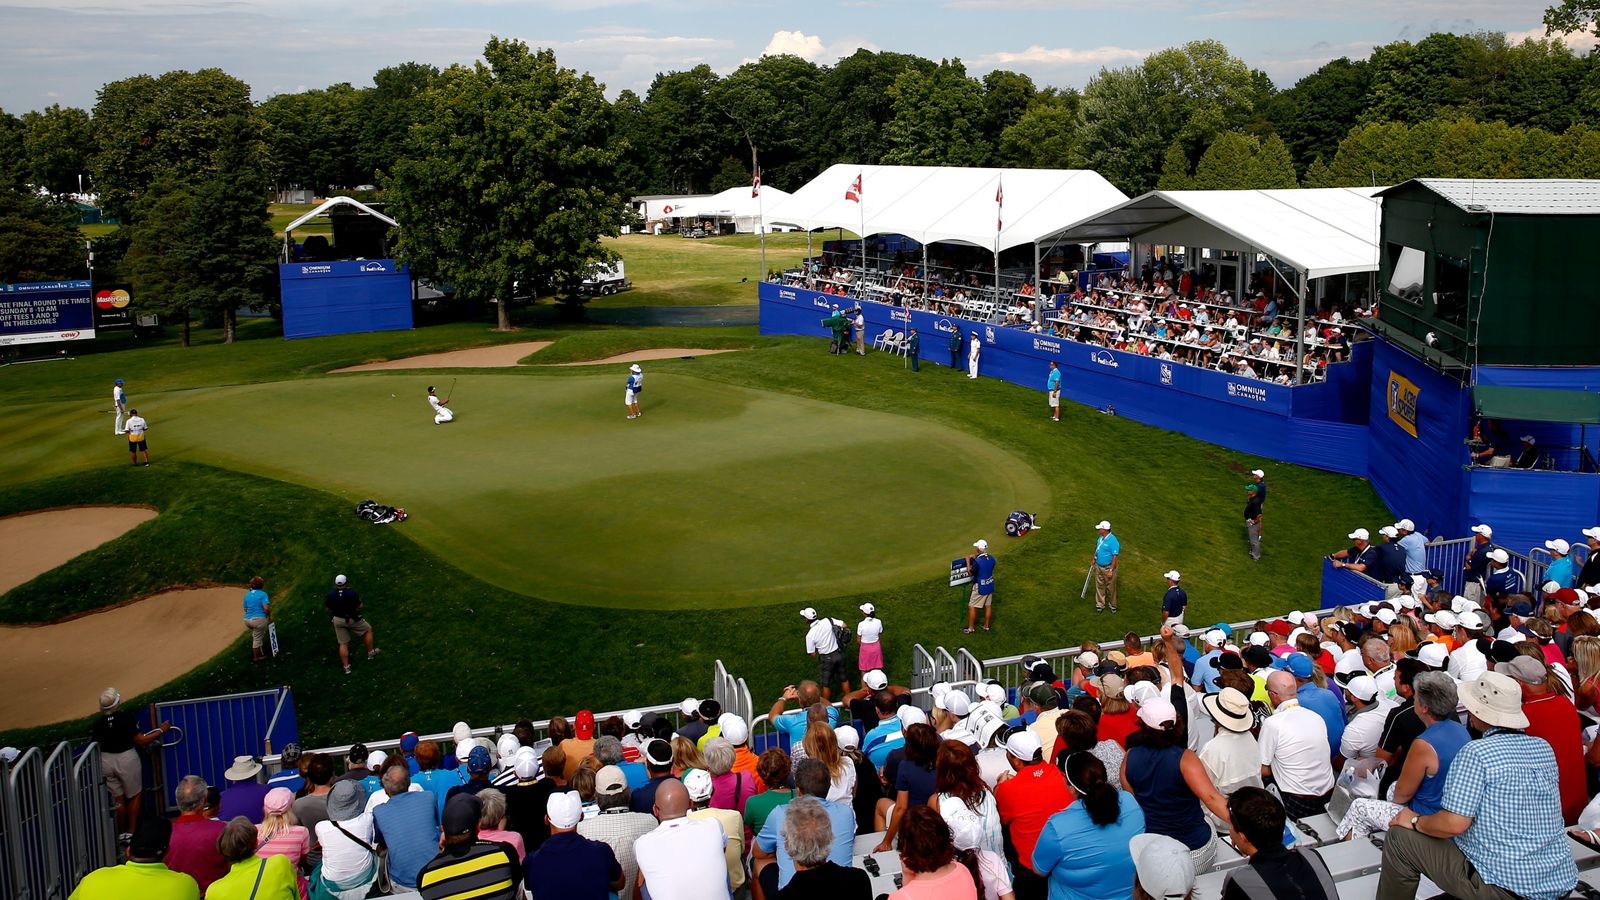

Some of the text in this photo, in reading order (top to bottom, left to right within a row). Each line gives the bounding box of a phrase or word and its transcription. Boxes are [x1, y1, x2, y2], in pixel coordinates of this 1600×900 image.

[33, 299, 57, 307] ROUND
[0, 307, 28, 315] SUNDAY
[12, 318, 57, 326] THREESOMES
[1040, 340, 1060, 348] OMNIUM
[1237, 384, 1266, 396] OMNIUM
[1237, 391, 1266, 401] CANADIEN
